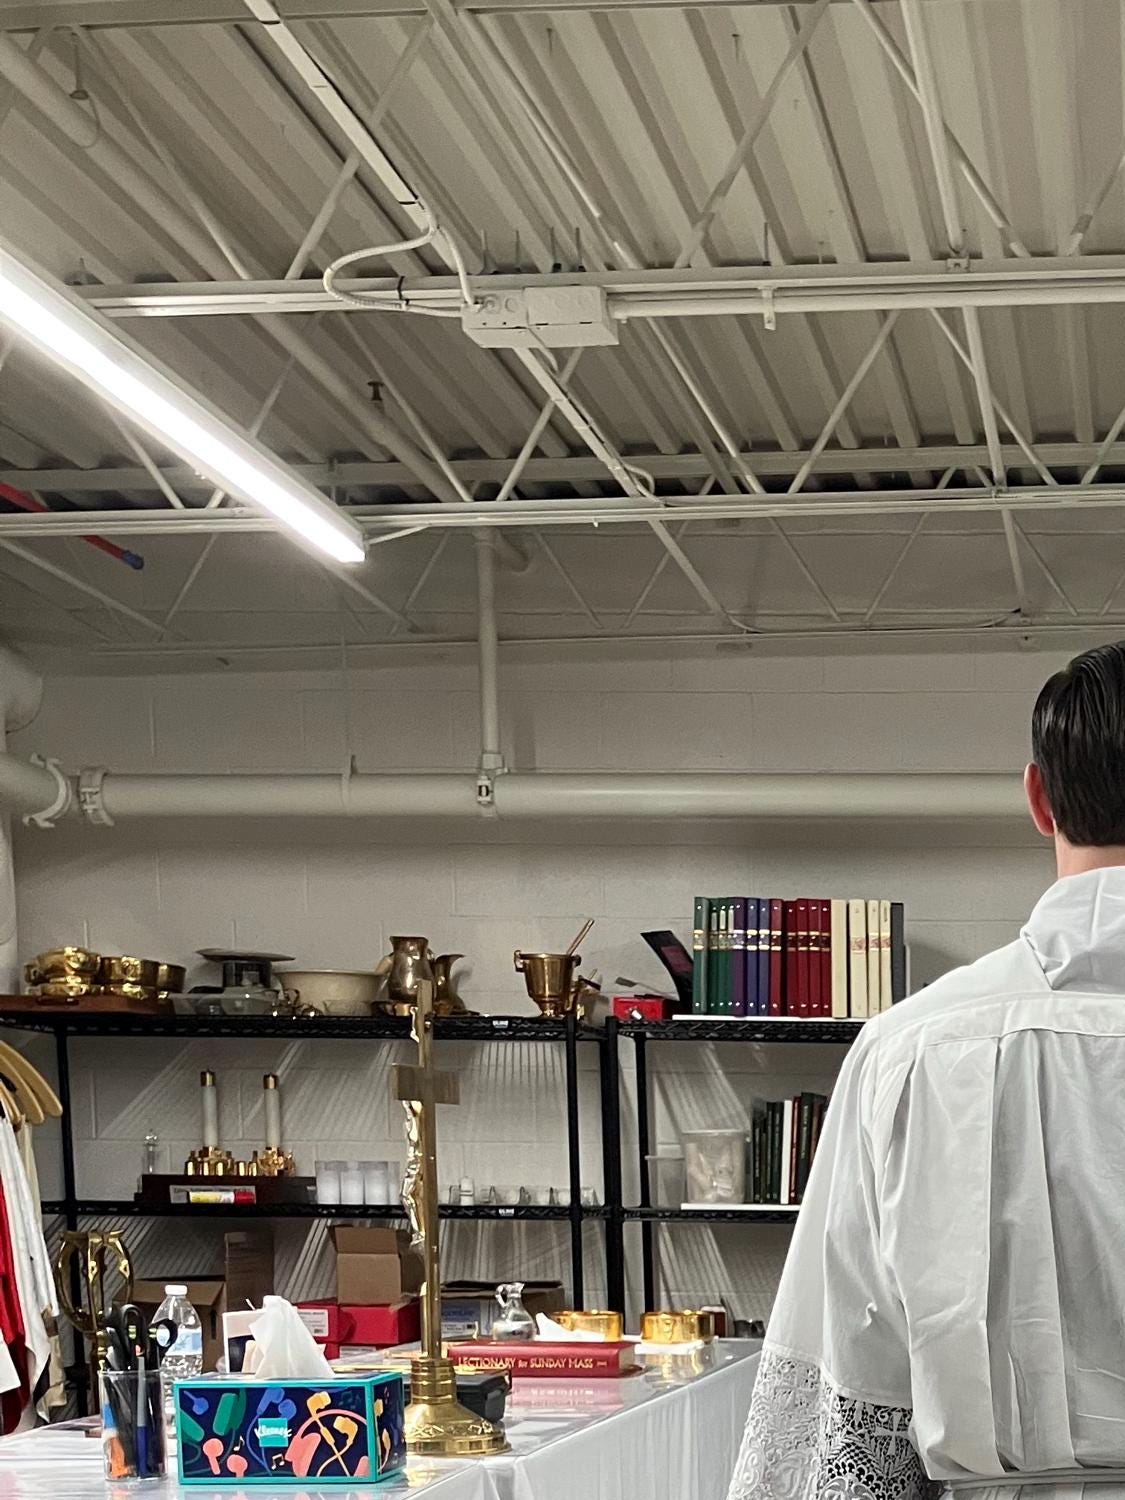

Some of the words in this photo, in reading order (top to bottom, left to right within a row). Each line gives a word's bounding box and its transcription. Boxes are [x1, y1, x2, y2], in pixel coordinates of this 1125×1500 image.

[458, 1357, 515, 1369] LECTIONARY
[518, 1359, 528, 1369] for
[530, 1357, 566, 1369] SUNDAY
[569, 1357, 594, 1369] MASS
